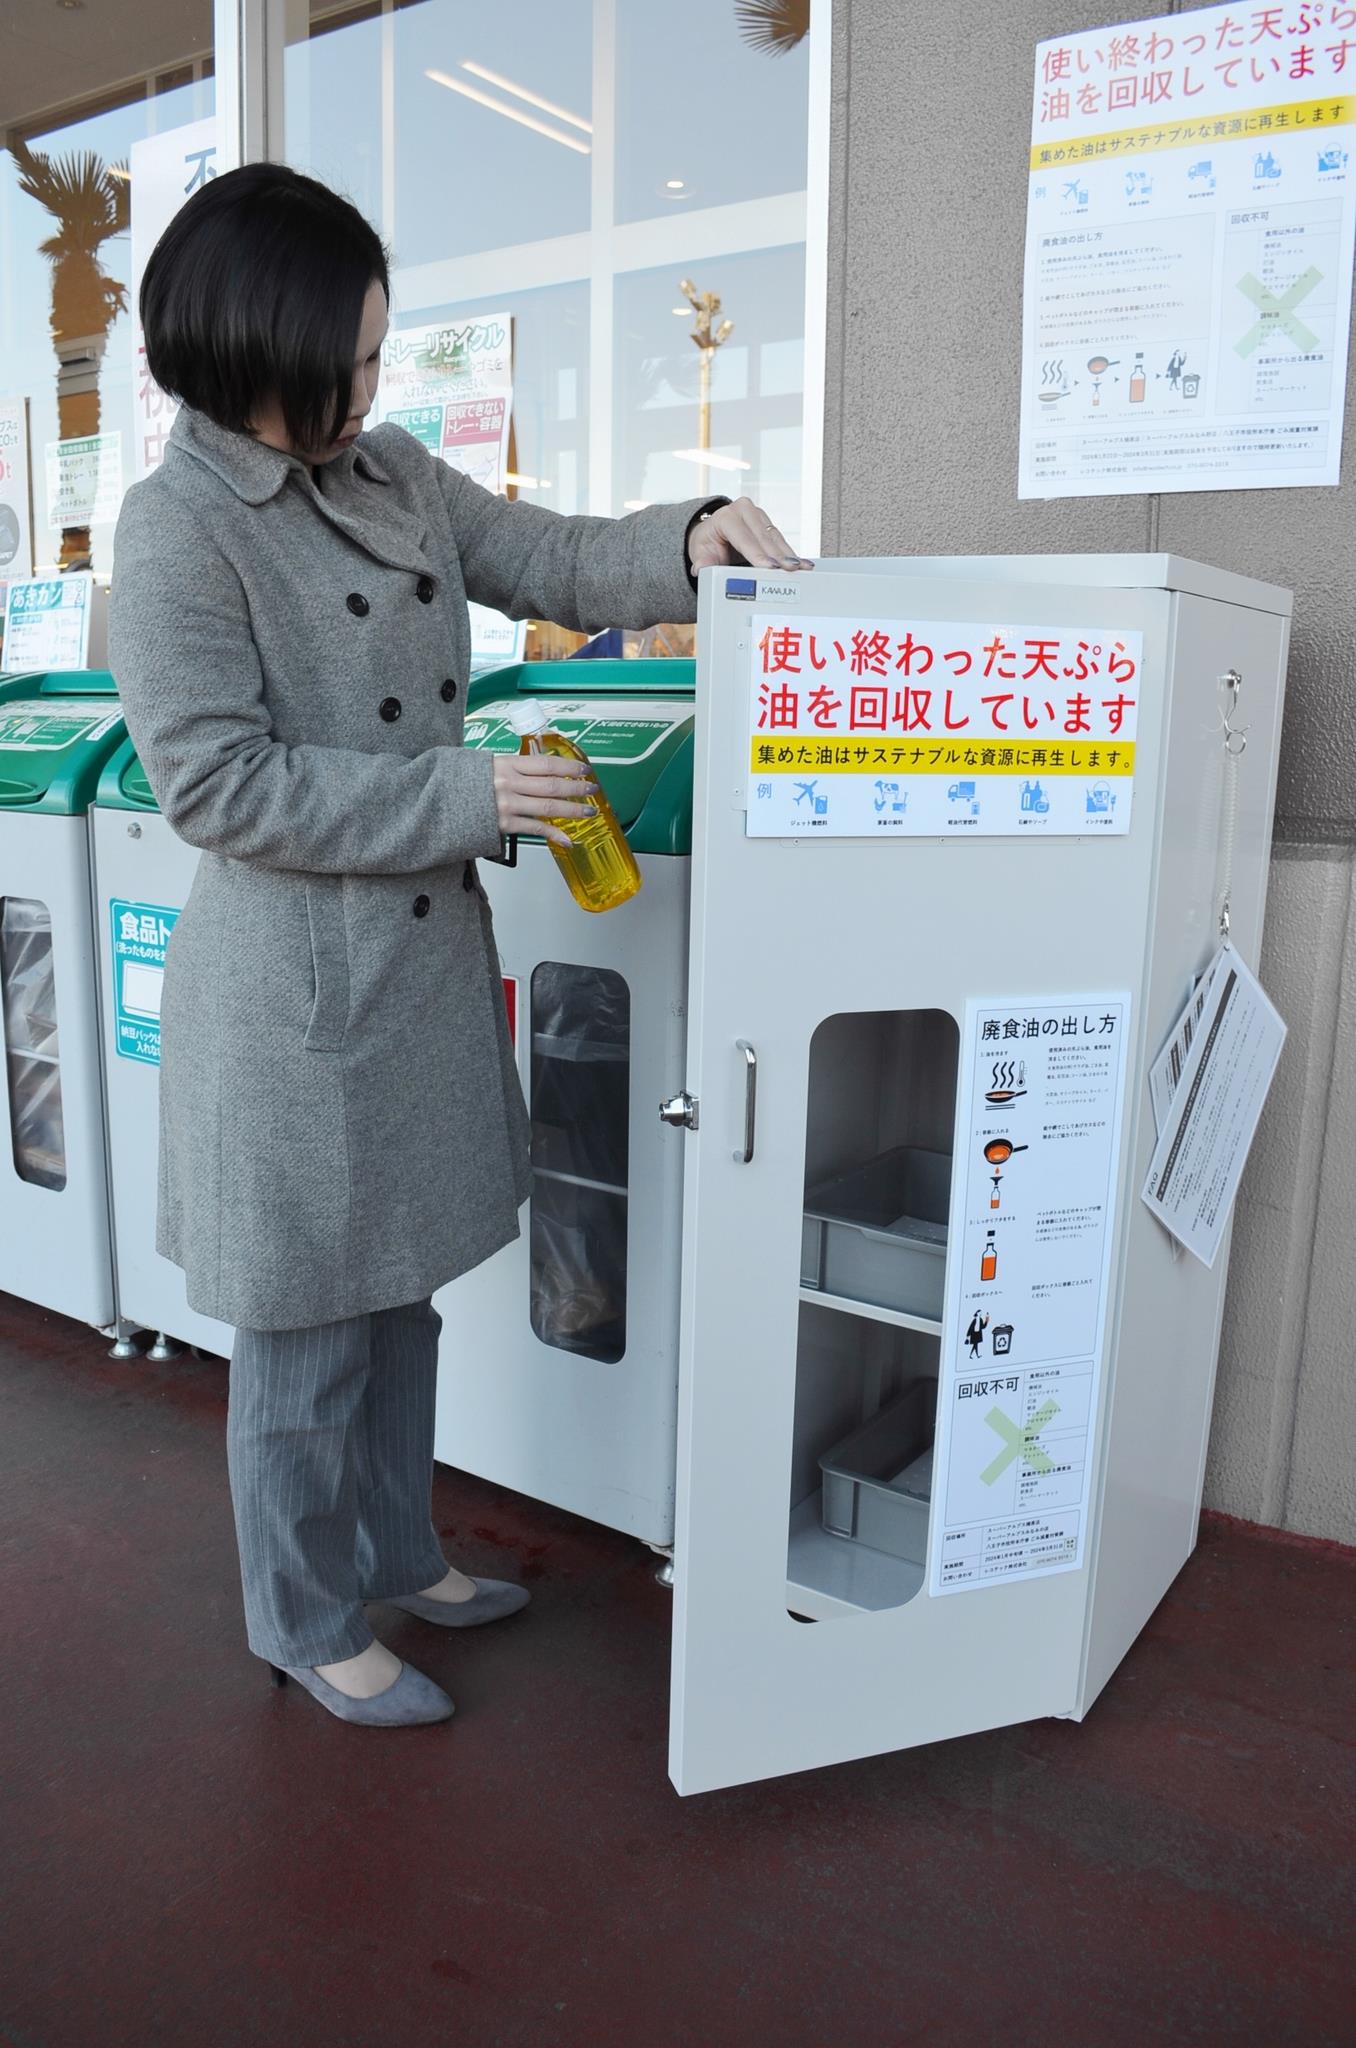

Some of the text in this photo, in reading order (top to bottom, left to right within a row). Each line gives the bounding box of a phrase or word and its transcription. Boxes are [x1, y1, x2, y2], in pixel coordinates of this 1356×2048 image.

[1042, 0, 1356, 84] 使い終わった天ぷら
[1040, 39, 1356, 122] 油を回収しています
[382, 323, 505, 367] トレーリサイクル
[447, 402, 504, 420] 回収できない
[758, 626, 1136, 683] 使い終わった天ぷら
[756, 684, 1136, 734] 油を回収しています
[757, 744, 1131, 769] 集めた油はサステナブルな資源に再生します。
[757, 783, 772, 799] 例
[120, 911, 176, 946] 食品ト
[981, 1014, 1117, 1041] 廃食油の出し方
[958, 1377, 1020, 1400] 回収不可
